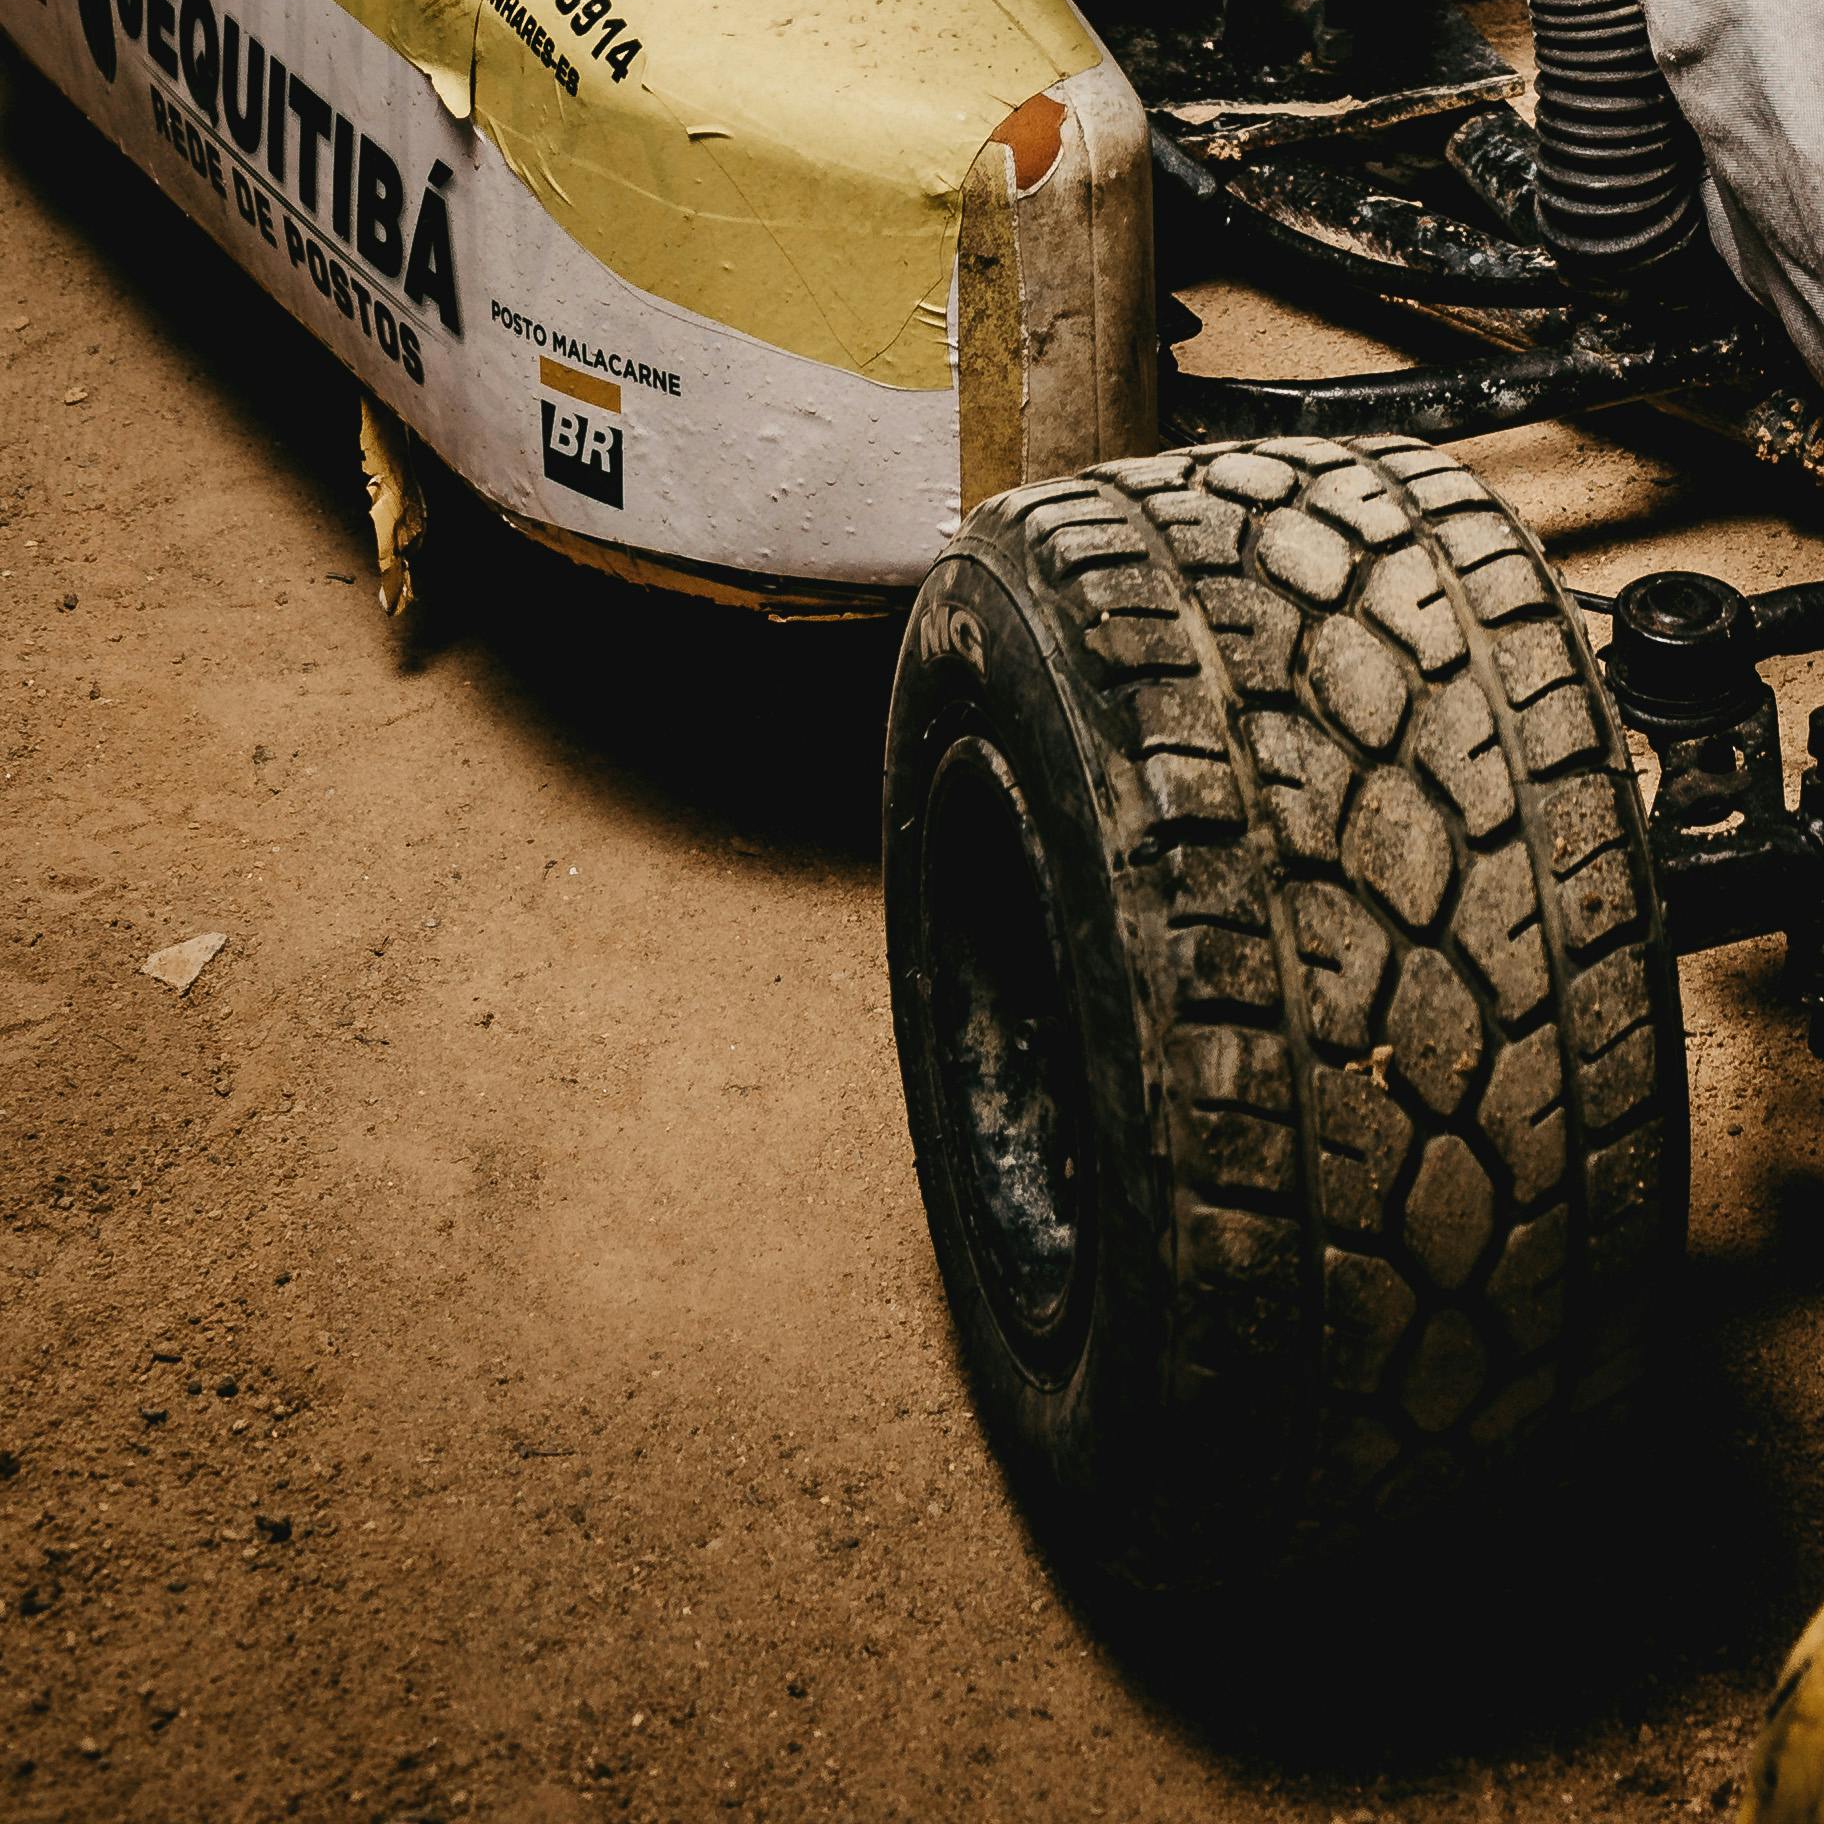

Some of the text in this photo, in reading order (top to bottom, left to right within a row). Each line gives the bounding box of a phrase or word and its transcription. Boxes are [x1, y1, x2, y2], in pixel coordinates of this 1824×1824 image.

[149, 83, 425, 386] REDE DE POSTOS
[490, 298, 683, 398] POSTO MALACARNE
[549, 406, 614, 473] BR
